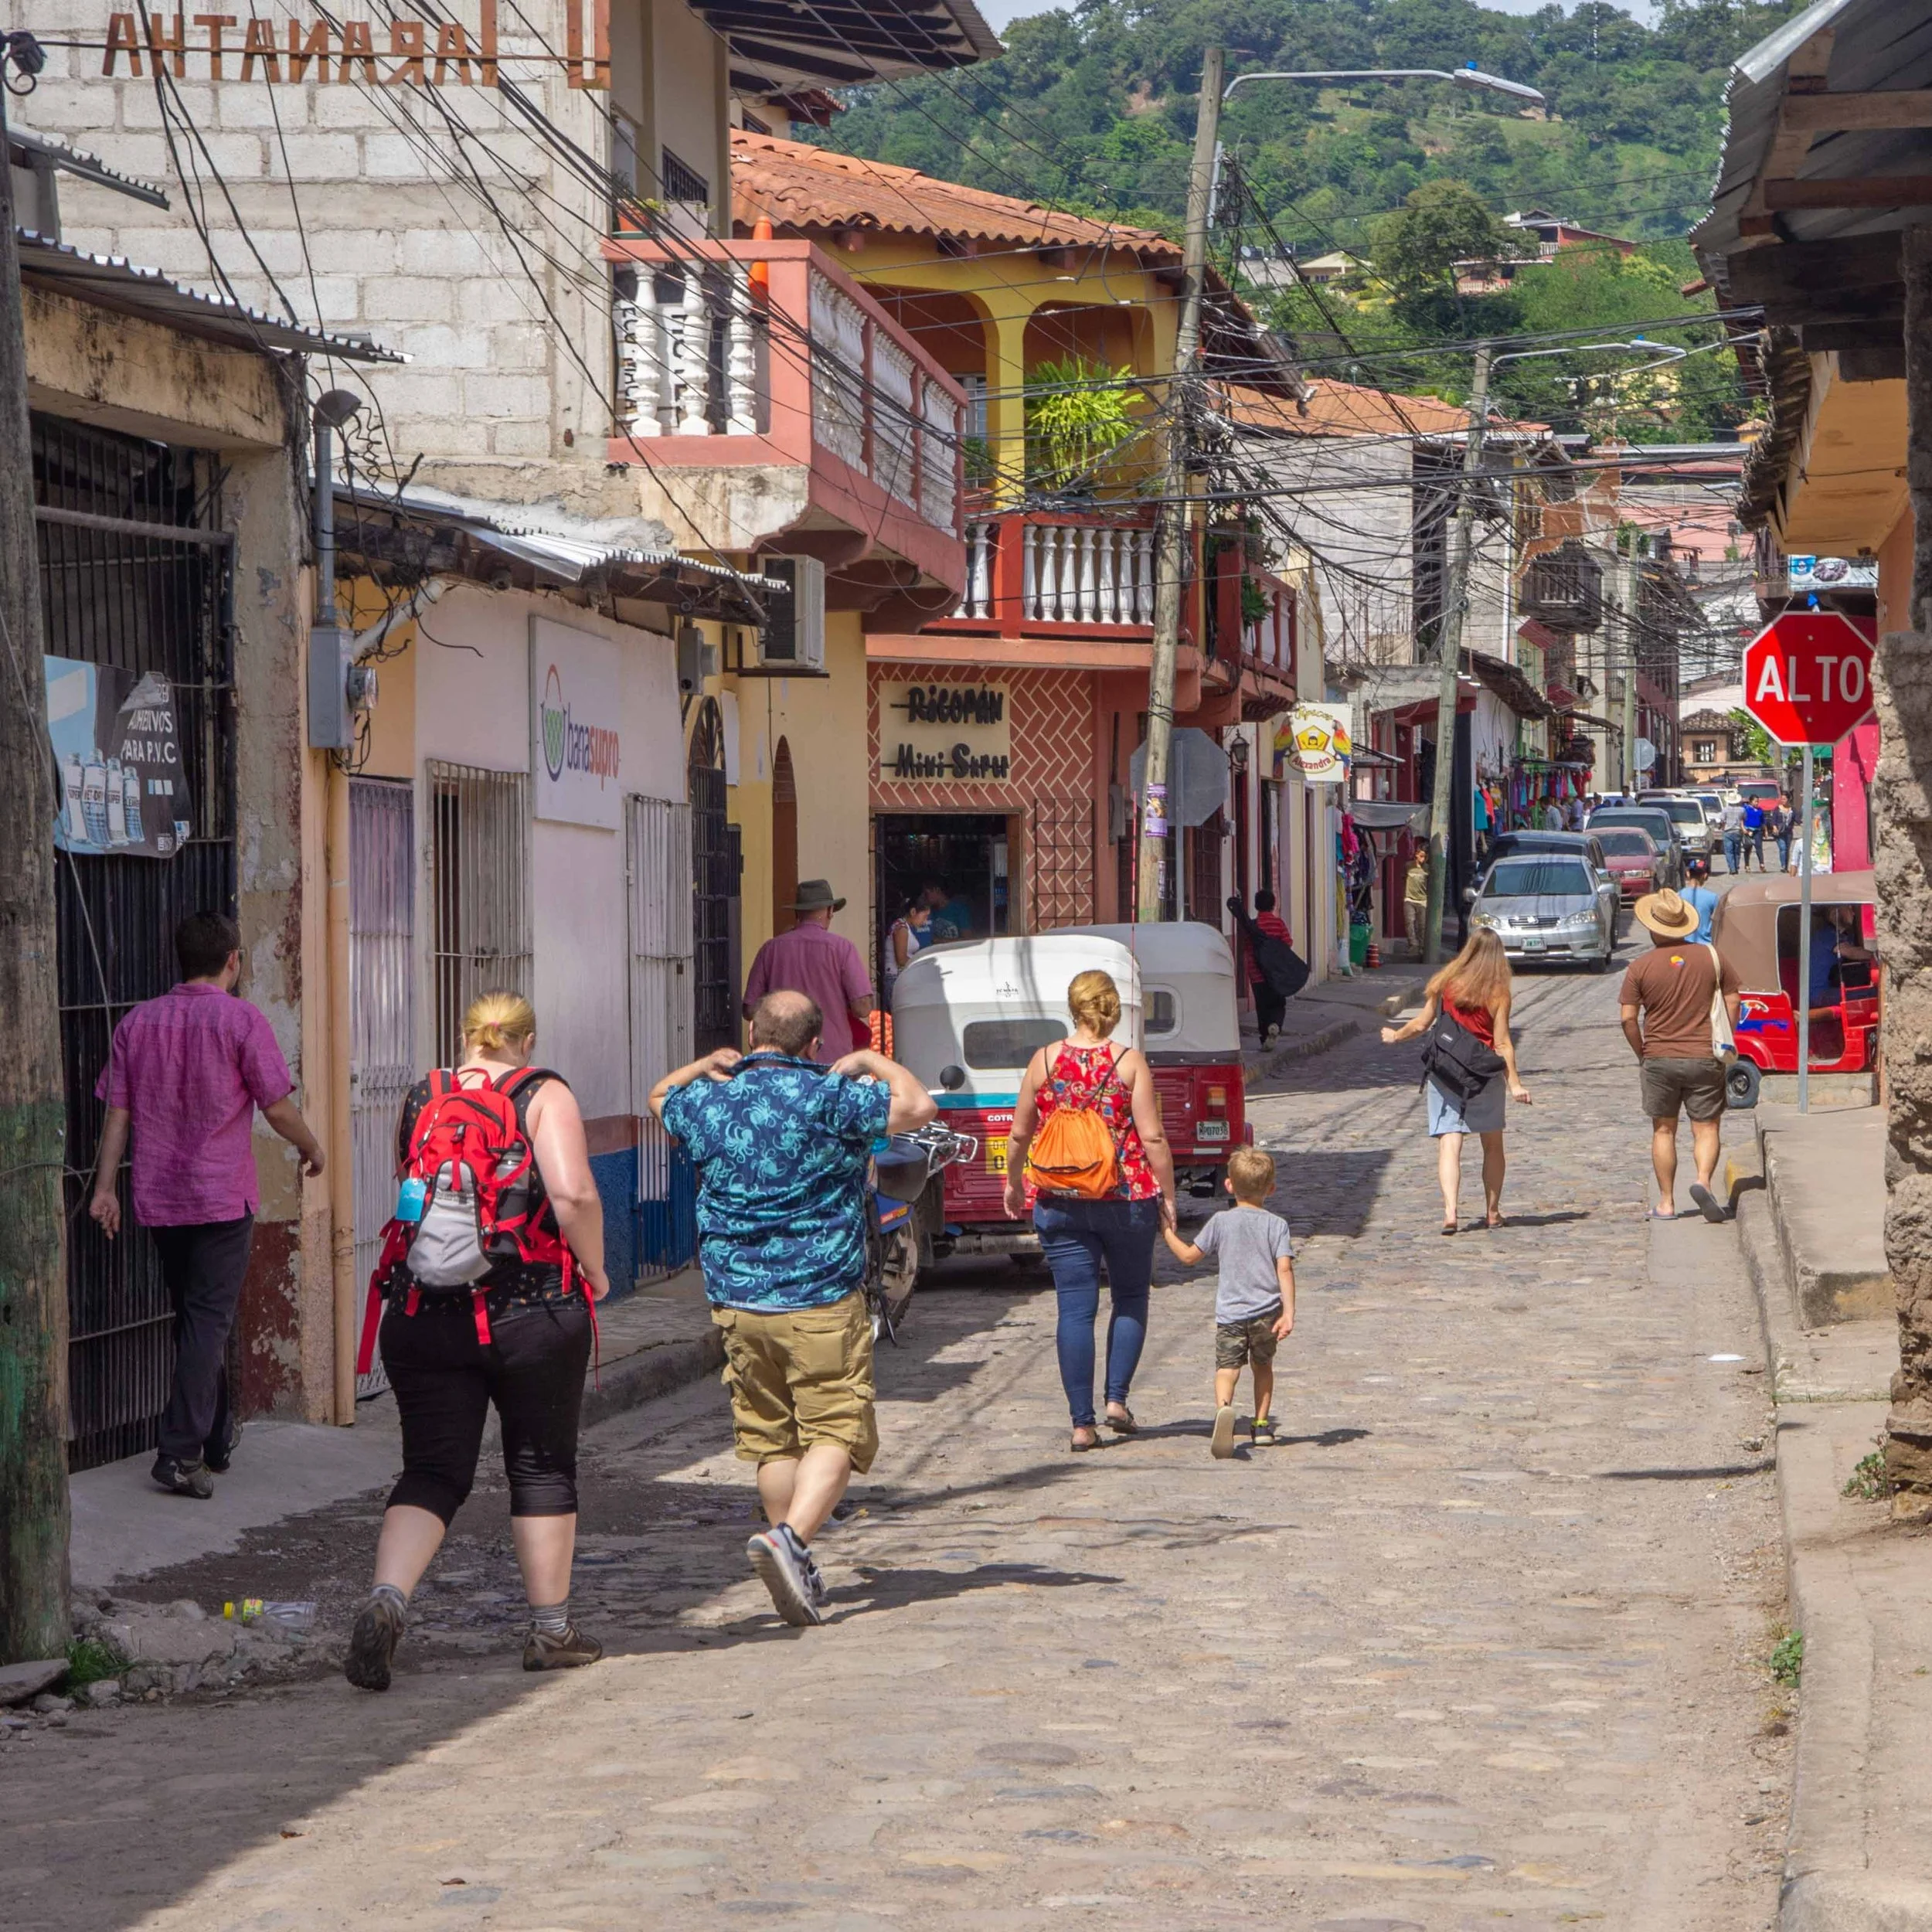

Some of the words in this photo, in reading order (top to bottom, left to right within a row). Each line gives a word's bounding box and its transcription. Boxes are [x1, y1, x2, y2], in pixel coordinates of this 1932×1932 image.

[1755, 655, 1865, 703] ALTO
[121, 739, 145, 761] PARA
[566, 702, 620, 791] banasupro
[1292, 757, 1332, 770] Alexandra
